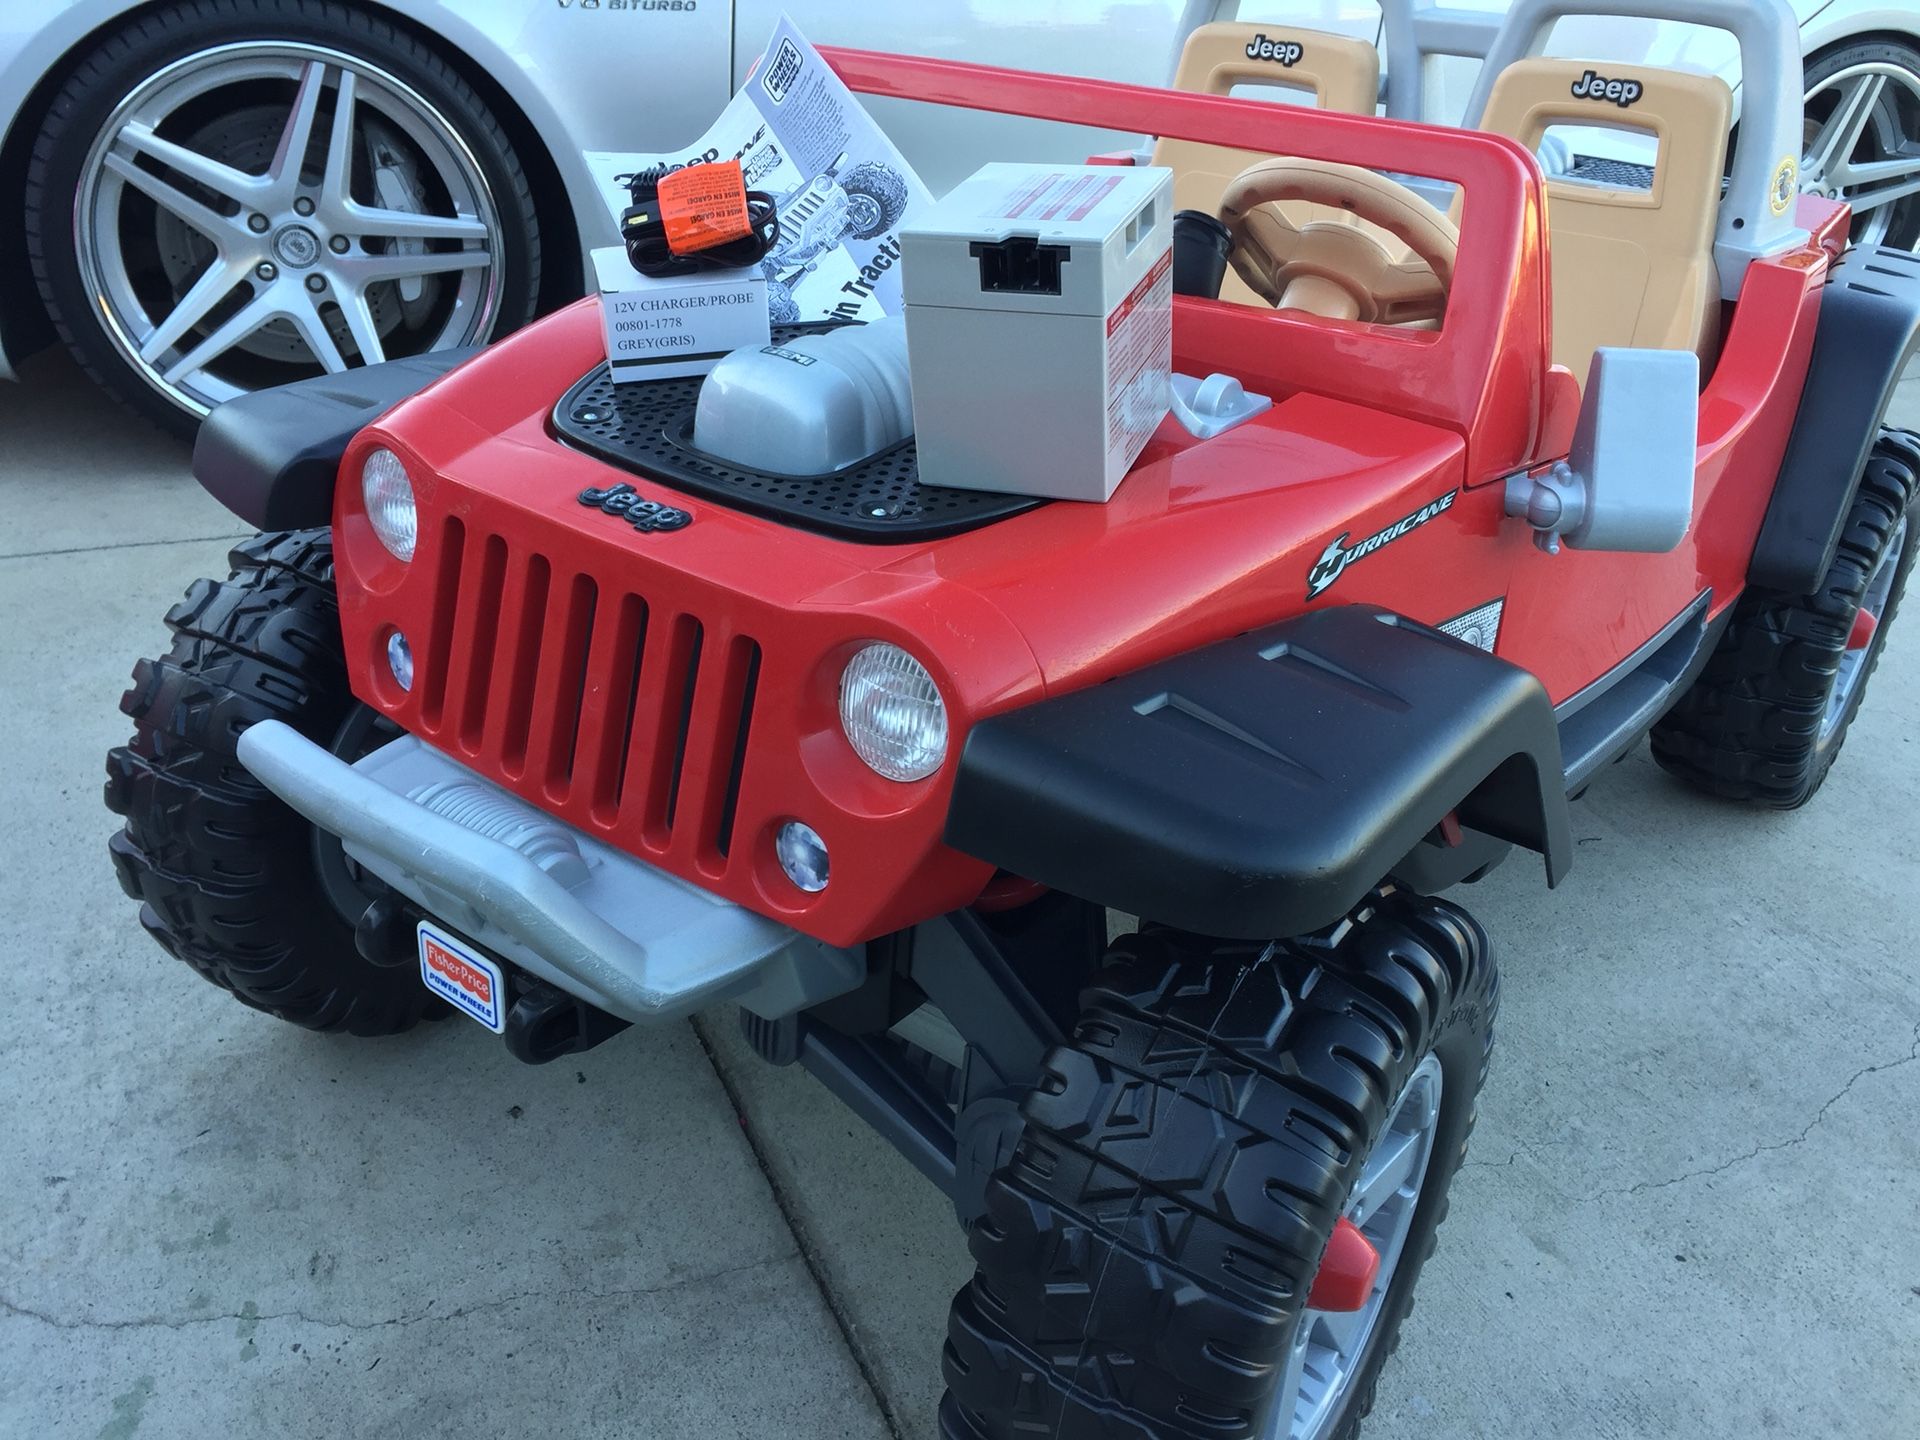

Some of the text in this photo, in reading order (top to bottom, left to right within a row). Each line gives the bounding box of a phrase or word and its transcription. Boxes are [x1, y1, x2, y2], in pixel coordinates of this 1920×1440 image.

[608, 0, 697, 11] BITURBO
[1246, 35, 1303, 67] Jeep
[768, 45, 790, 85] POWER
[772, 50, 797, 92] WHEELS
[1572, 71, 1642, 106] Jeep
[713, 193, 723, 201] EN
[723, 191, 741, 199] MISE
[715, 210, 725, 218] EN
[725, 207, 743, 217] MISE
[614, 292, 754, 314] 12V CHARGER/PROBE
[615, 317, 683, 332] 00801-1778
[617, 334, 696, 351] GREY(GRIS)
[578, 482, 693, 532] Jeep
[1306, 489, 1458, 600] HURRICANE
[429, 972, 492, 1017] POWER WHEELS
